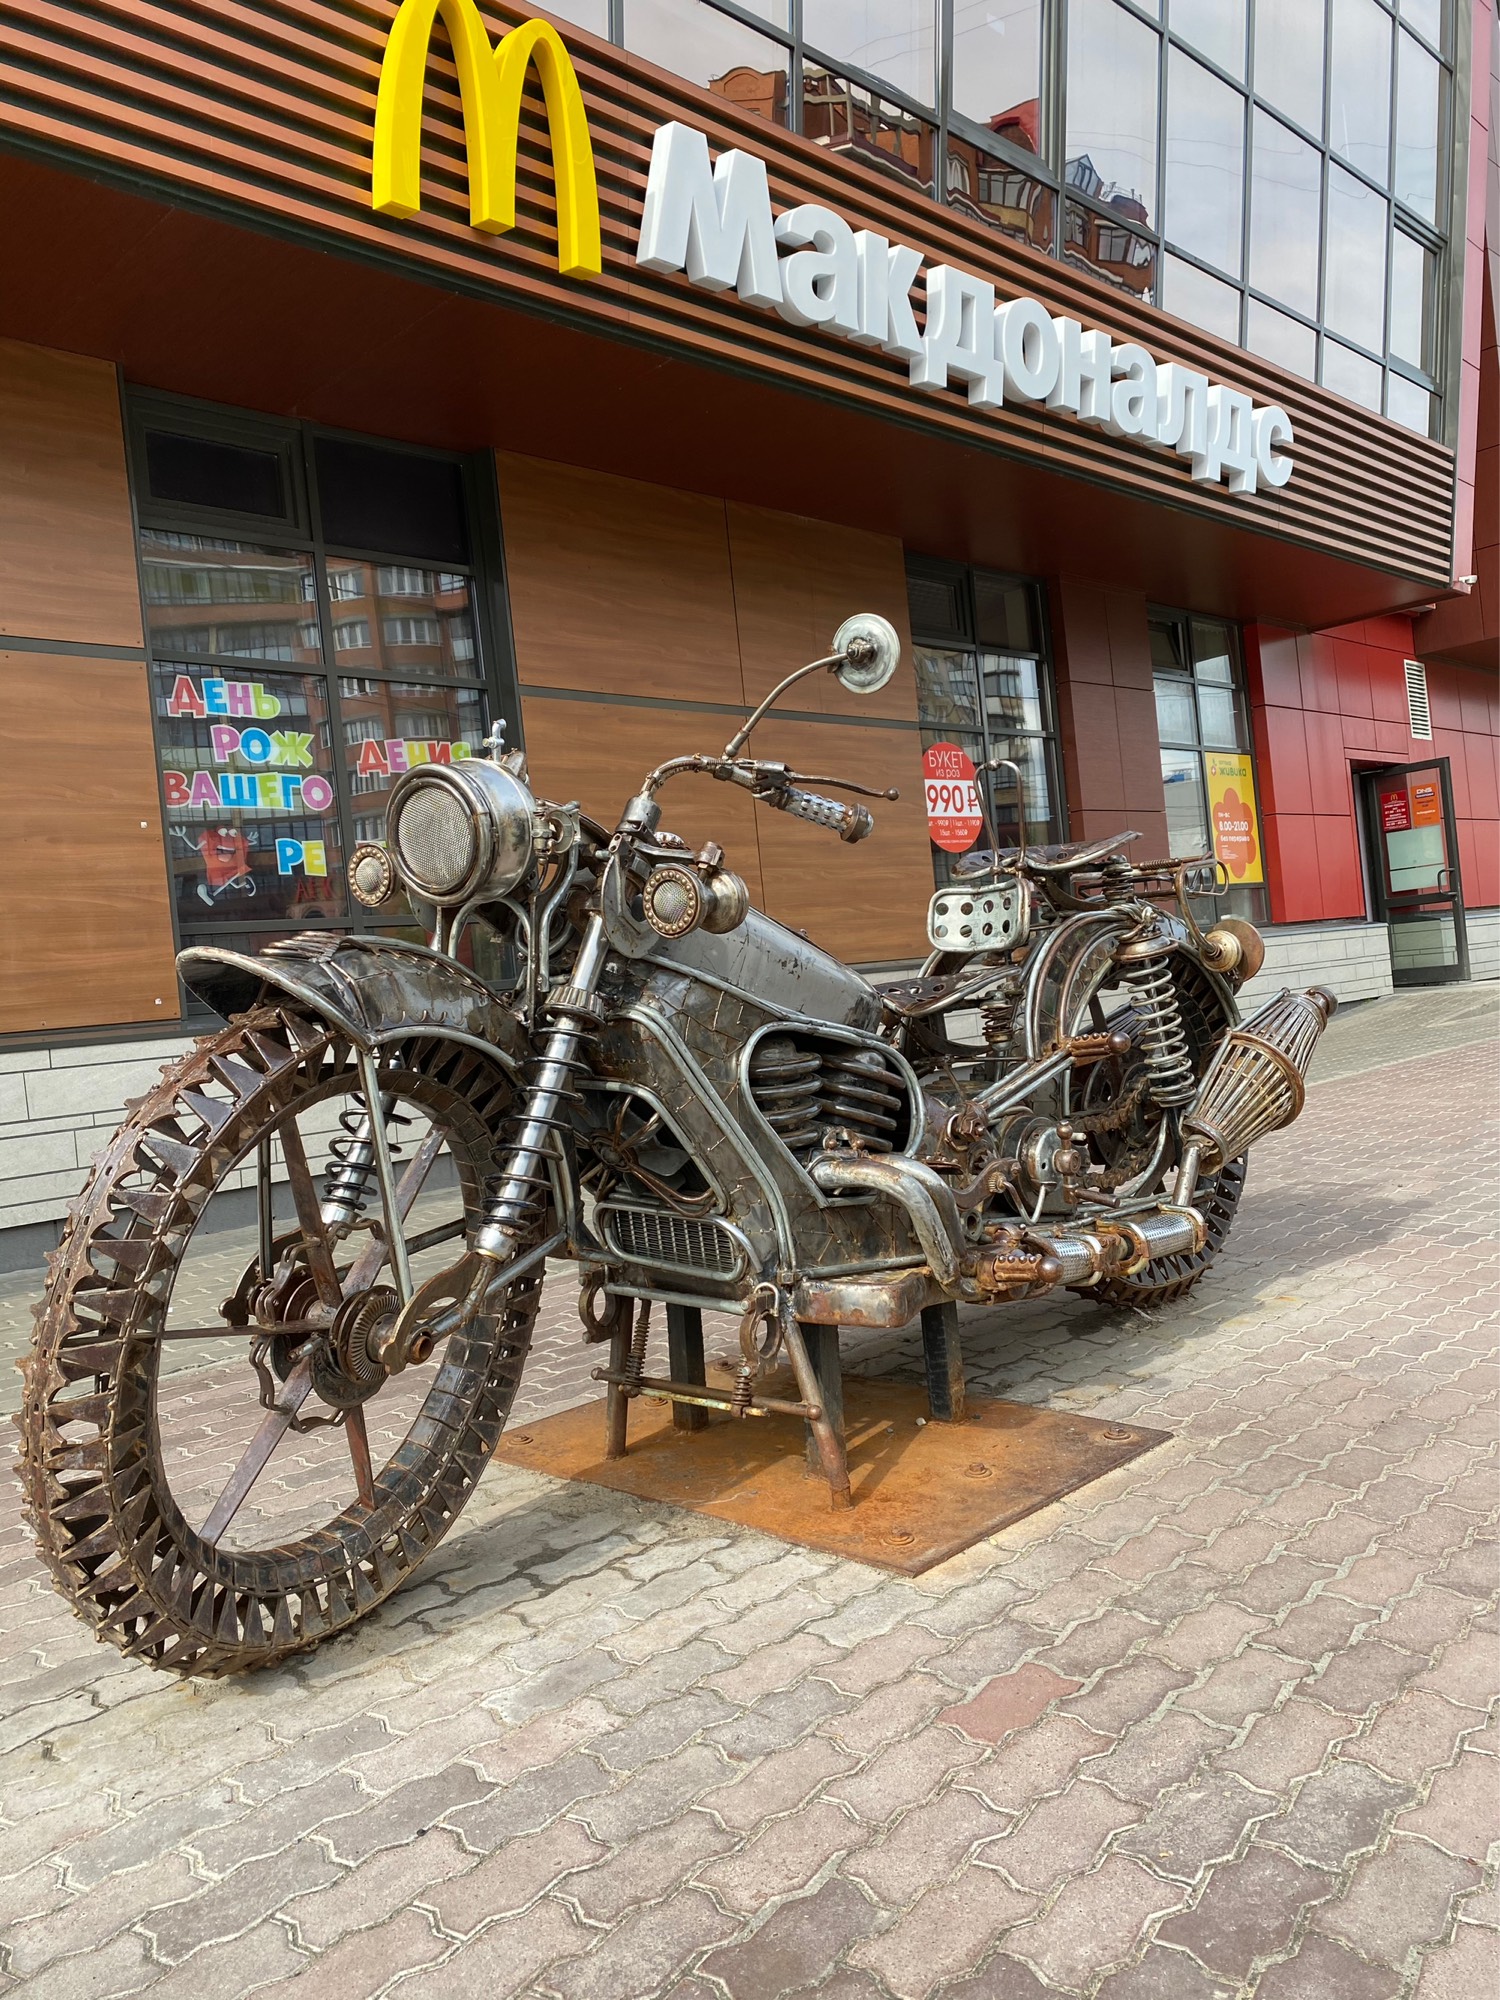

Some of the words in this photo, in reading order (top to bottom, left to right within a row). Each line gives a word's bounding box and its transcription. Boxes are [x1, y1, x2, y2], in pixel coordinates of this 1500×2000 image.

[636, 120, 1294, 495] Макдоналдс
[166, 674, 282, 719] ДЕНЬ
[210, 723, 315, 768] РОЖ
[928, 750, 964, 768] БУКЕТ
[162, 770, 333, 811] ВАШЕГО
[946, 769, 960, 779] роз
[927, 784, 964, 813] 990
[275, 838, 327, 877] РЕ
